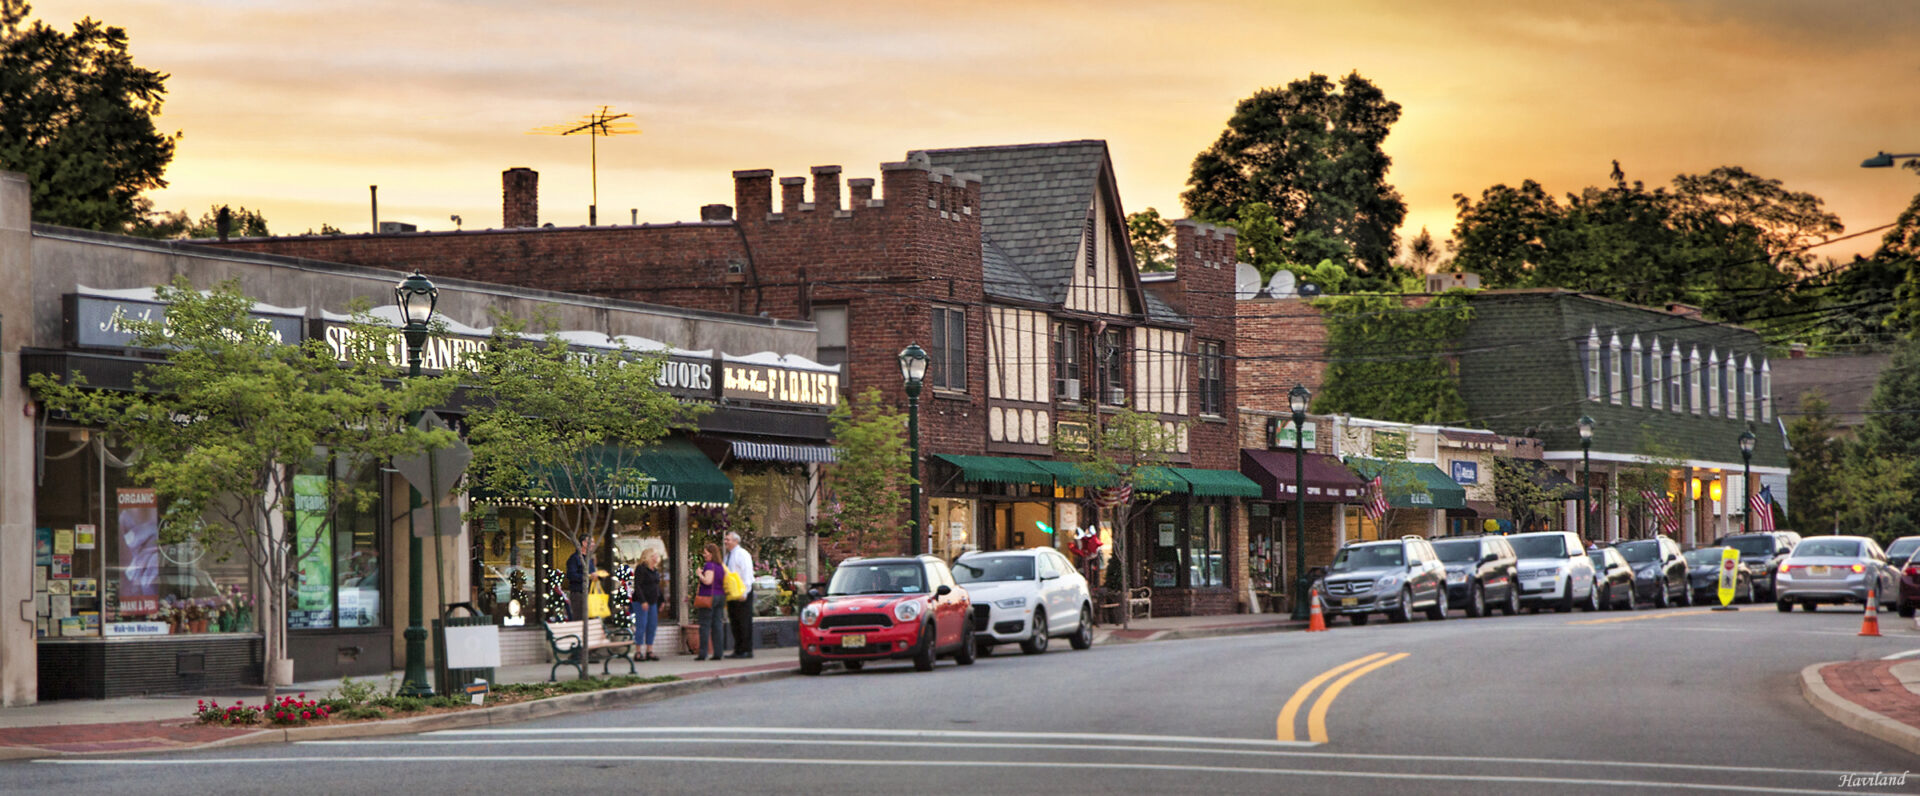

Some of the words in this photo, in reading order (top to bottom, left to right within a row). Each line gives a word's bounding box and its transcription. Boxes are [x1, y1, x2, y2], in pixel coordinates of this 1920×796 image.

[385, 331, 489, 373] CLANERS
[767, 368, 839, 405] FLORIST
[118, 493, 154, 505] ORGANIC
[651, 484, 677, 499] PIZZA
